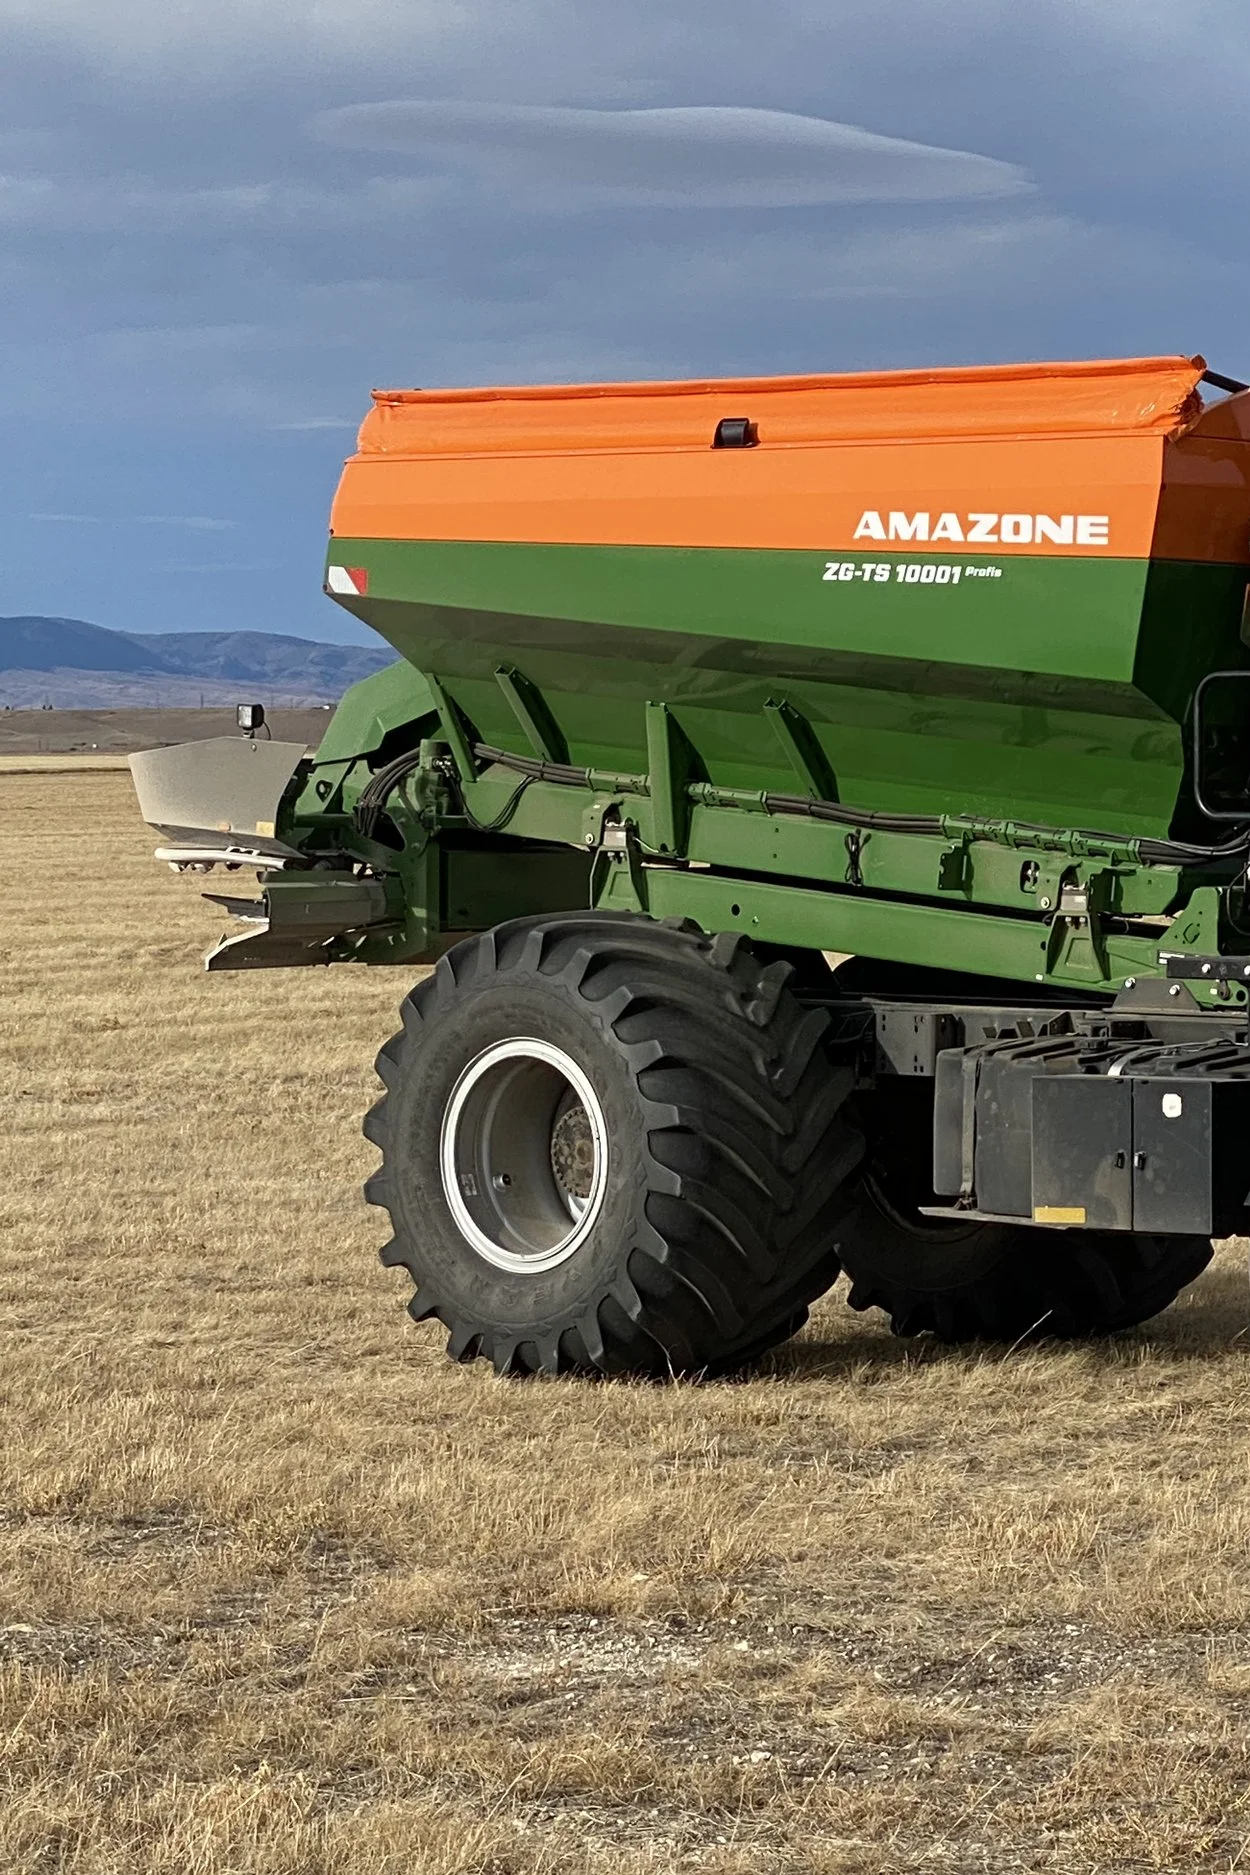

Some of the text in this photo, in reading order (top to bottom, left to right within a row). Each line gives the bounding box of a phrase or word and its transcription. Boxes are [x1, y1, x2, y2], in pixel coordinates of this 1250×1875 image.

[852, 510, 1109, 545] AMAZONE
[822, 562, 891, 582] ZG-TS
[896, 564, 962, 584] 10001
